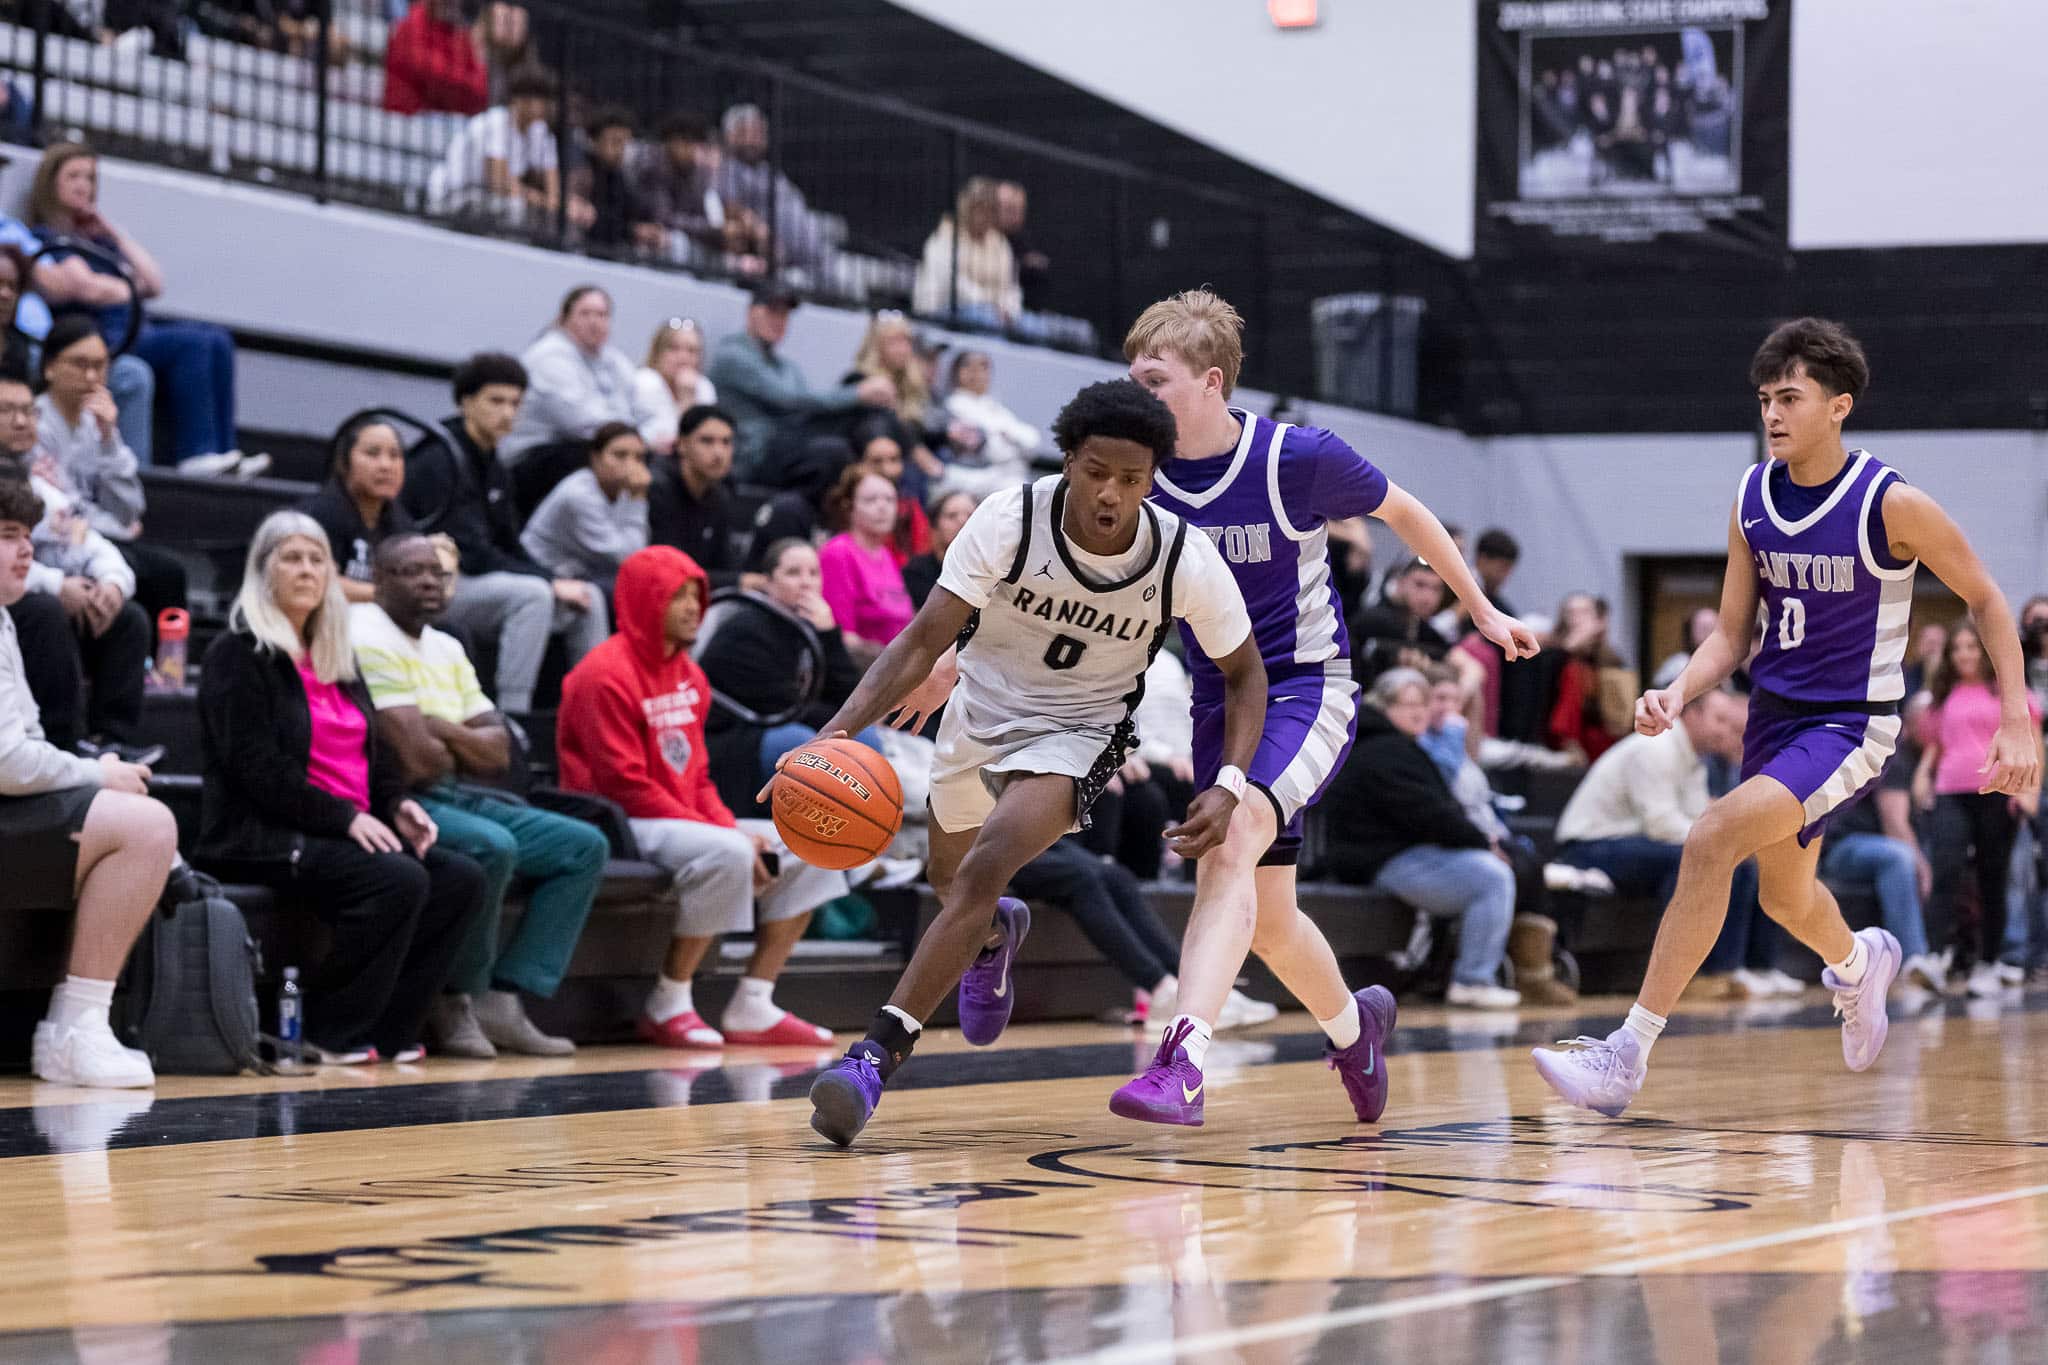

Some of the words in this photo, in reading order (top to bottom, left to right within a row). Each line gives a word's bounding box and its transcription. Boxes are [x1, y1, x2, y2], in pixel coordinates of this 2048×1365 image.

[1200, 523, 1271, 563] YON
[1755, 551, 1854, 592] ANYON
[1779, 597, 1806, 650] 0
[1043, 633, 1087, 670] 0
[815, 758, 872, 802] ELITE
